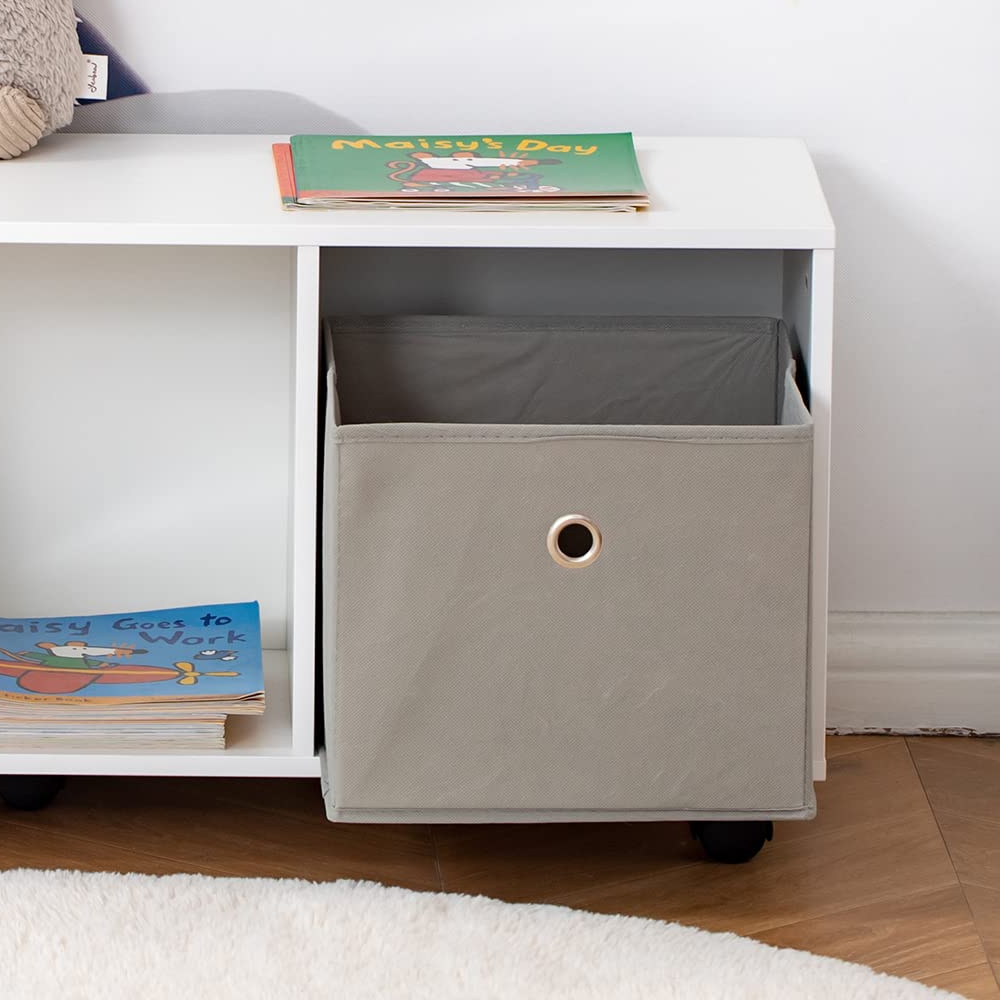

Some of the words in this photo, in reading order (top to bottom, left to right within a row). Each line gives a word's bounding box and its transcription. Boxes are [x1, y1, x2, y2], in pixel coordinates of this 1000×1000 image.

[331, 137, 503, 151] Maisy's
[516, 139, 598, 156] Day
[112, 617, 186, 631] Goes
[200, 613, 232, 627] to
[139, 630, 247, 646] Work
